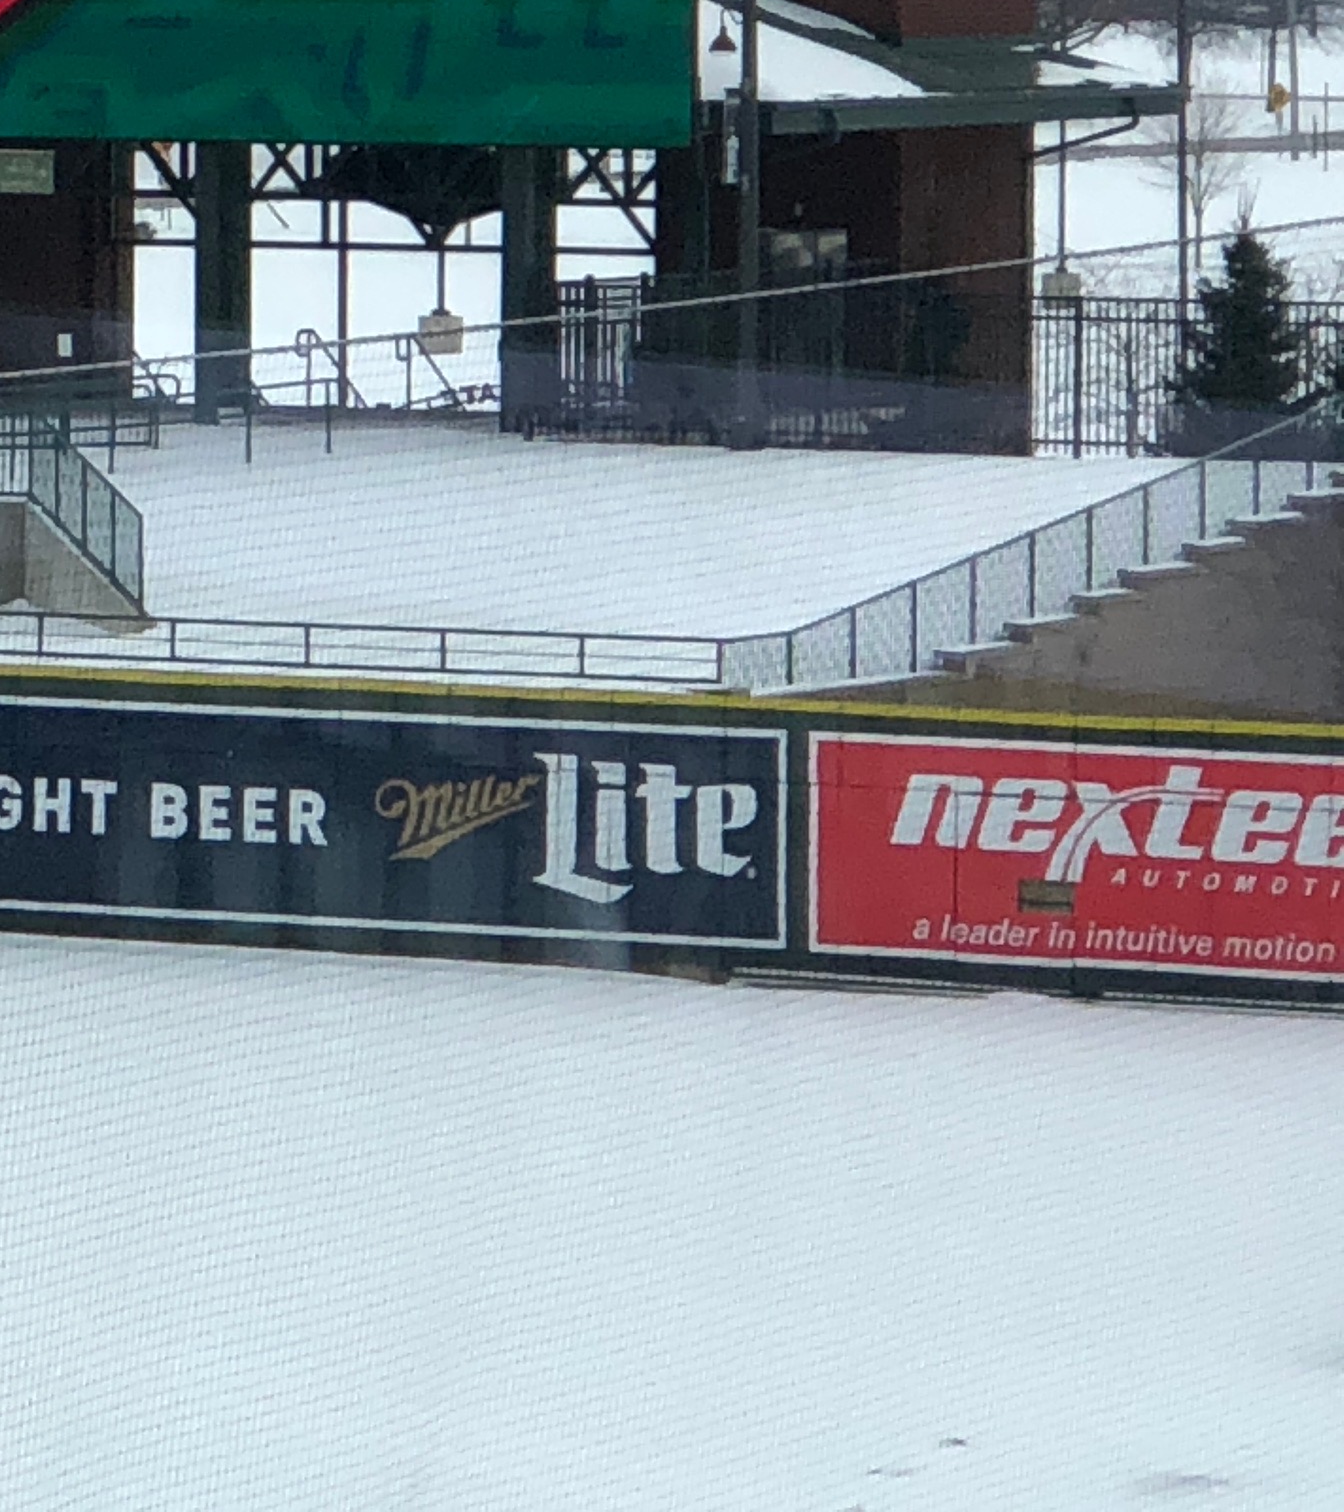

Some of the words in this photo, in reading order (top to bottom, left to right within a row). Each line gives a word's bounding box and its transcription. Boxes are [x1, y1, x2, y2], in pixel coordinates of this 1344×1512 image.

[148, 781, 328, 847] BEER
[375, 774, 544, 854] Miller
[532, 751, 758, 904] Lite
[912, 916, 931, 941] a
[940, 913, 1038, 947] leader
[1047, 920, 1077, 950] in
[1085, 921, 1214, 956] intuitive
[1222, 931, 1336, 964] motion
